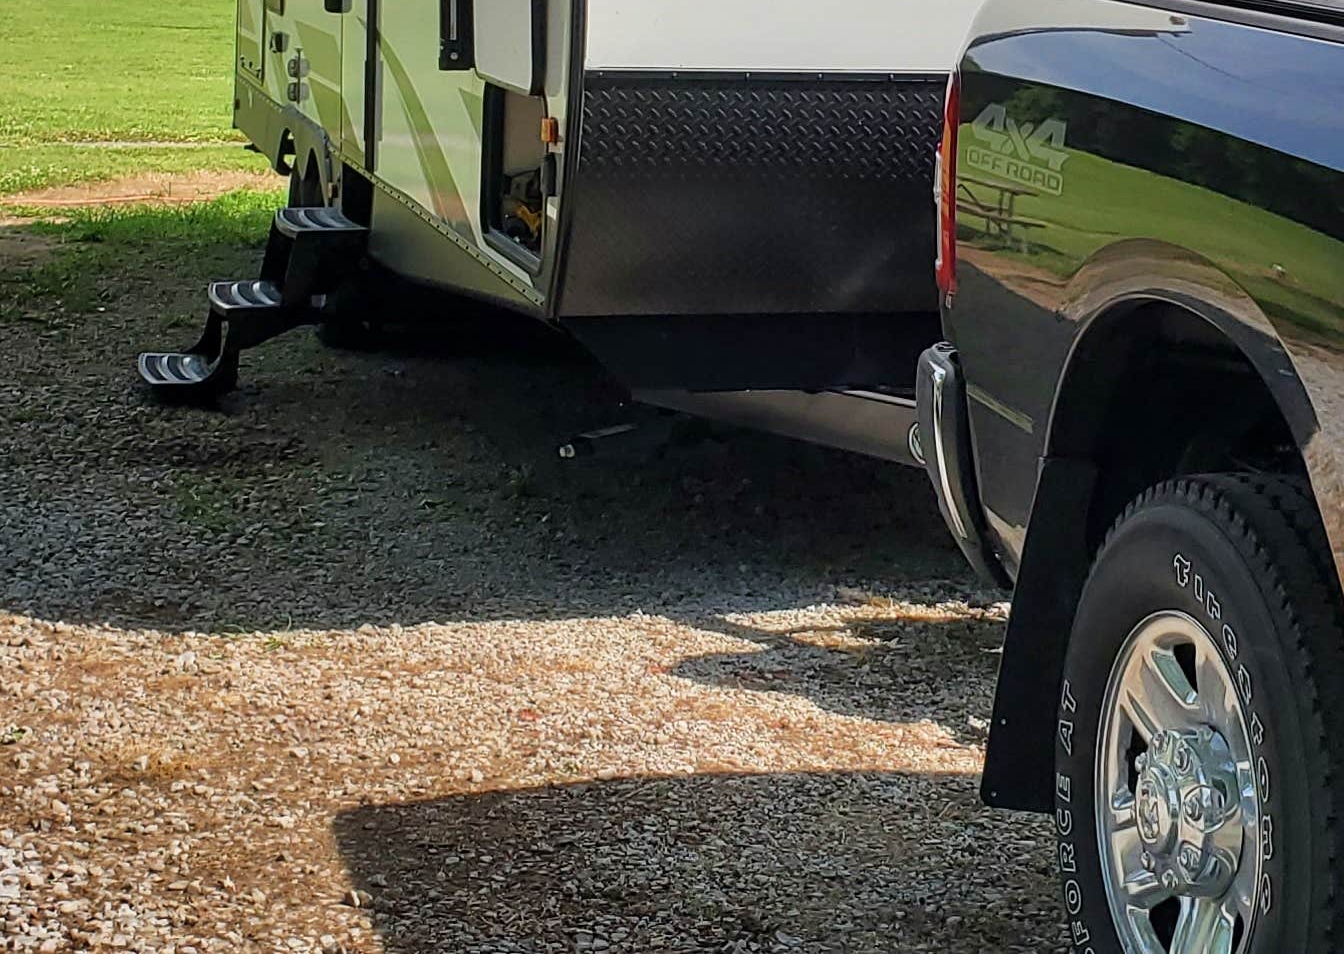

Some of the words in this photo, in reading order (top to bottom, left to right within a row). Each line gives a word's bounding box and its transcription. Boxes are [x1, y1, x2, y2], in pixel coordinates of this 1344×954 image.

[968, 149, 1003, 173] OFF
[1006, 161, 1062, 192] ROAD
[1058, 679, 1076, 757] AT
[1173, 554, 1273, 915] Firestone
